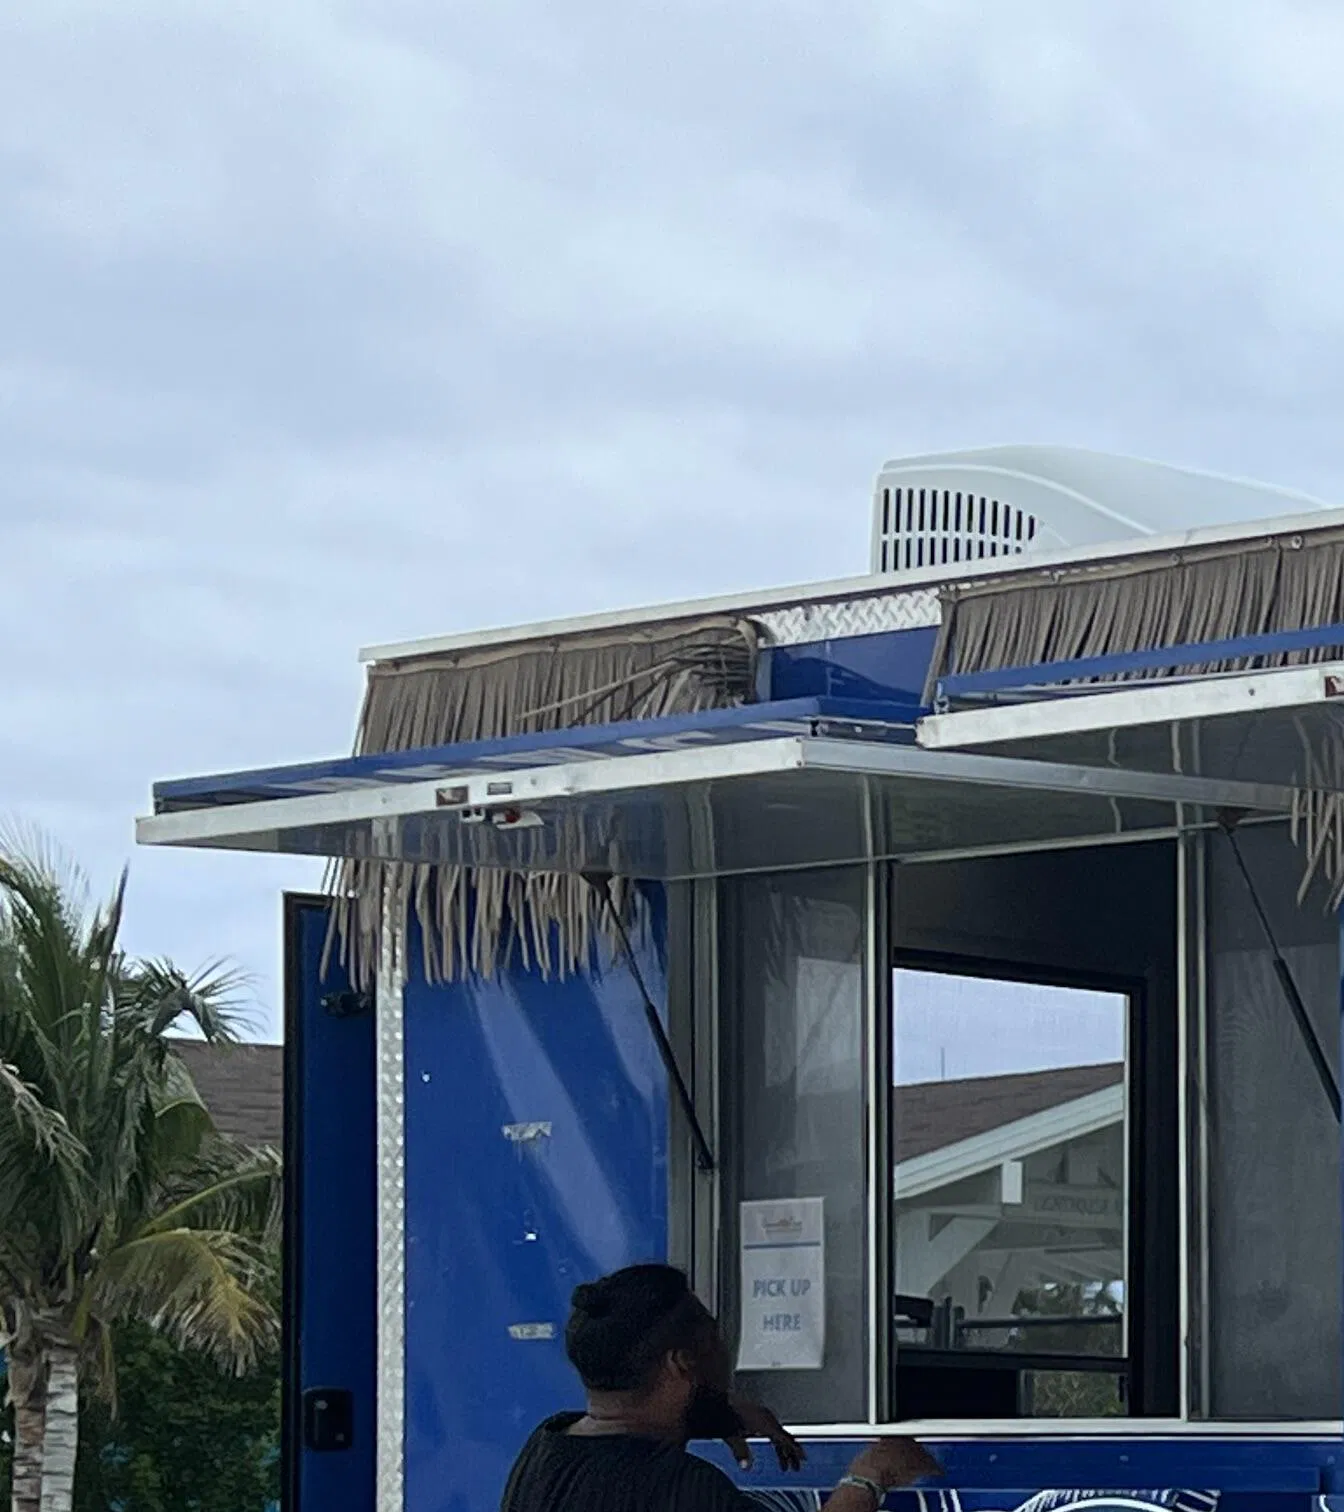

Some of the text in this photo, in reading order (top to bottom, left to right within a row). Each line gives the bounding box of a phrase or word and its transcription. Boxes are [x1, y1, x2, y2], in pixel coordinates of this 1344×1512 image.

[752, 1278, 811, 1298] PICK UP
[763, 1312, 801, 1331] HERE
